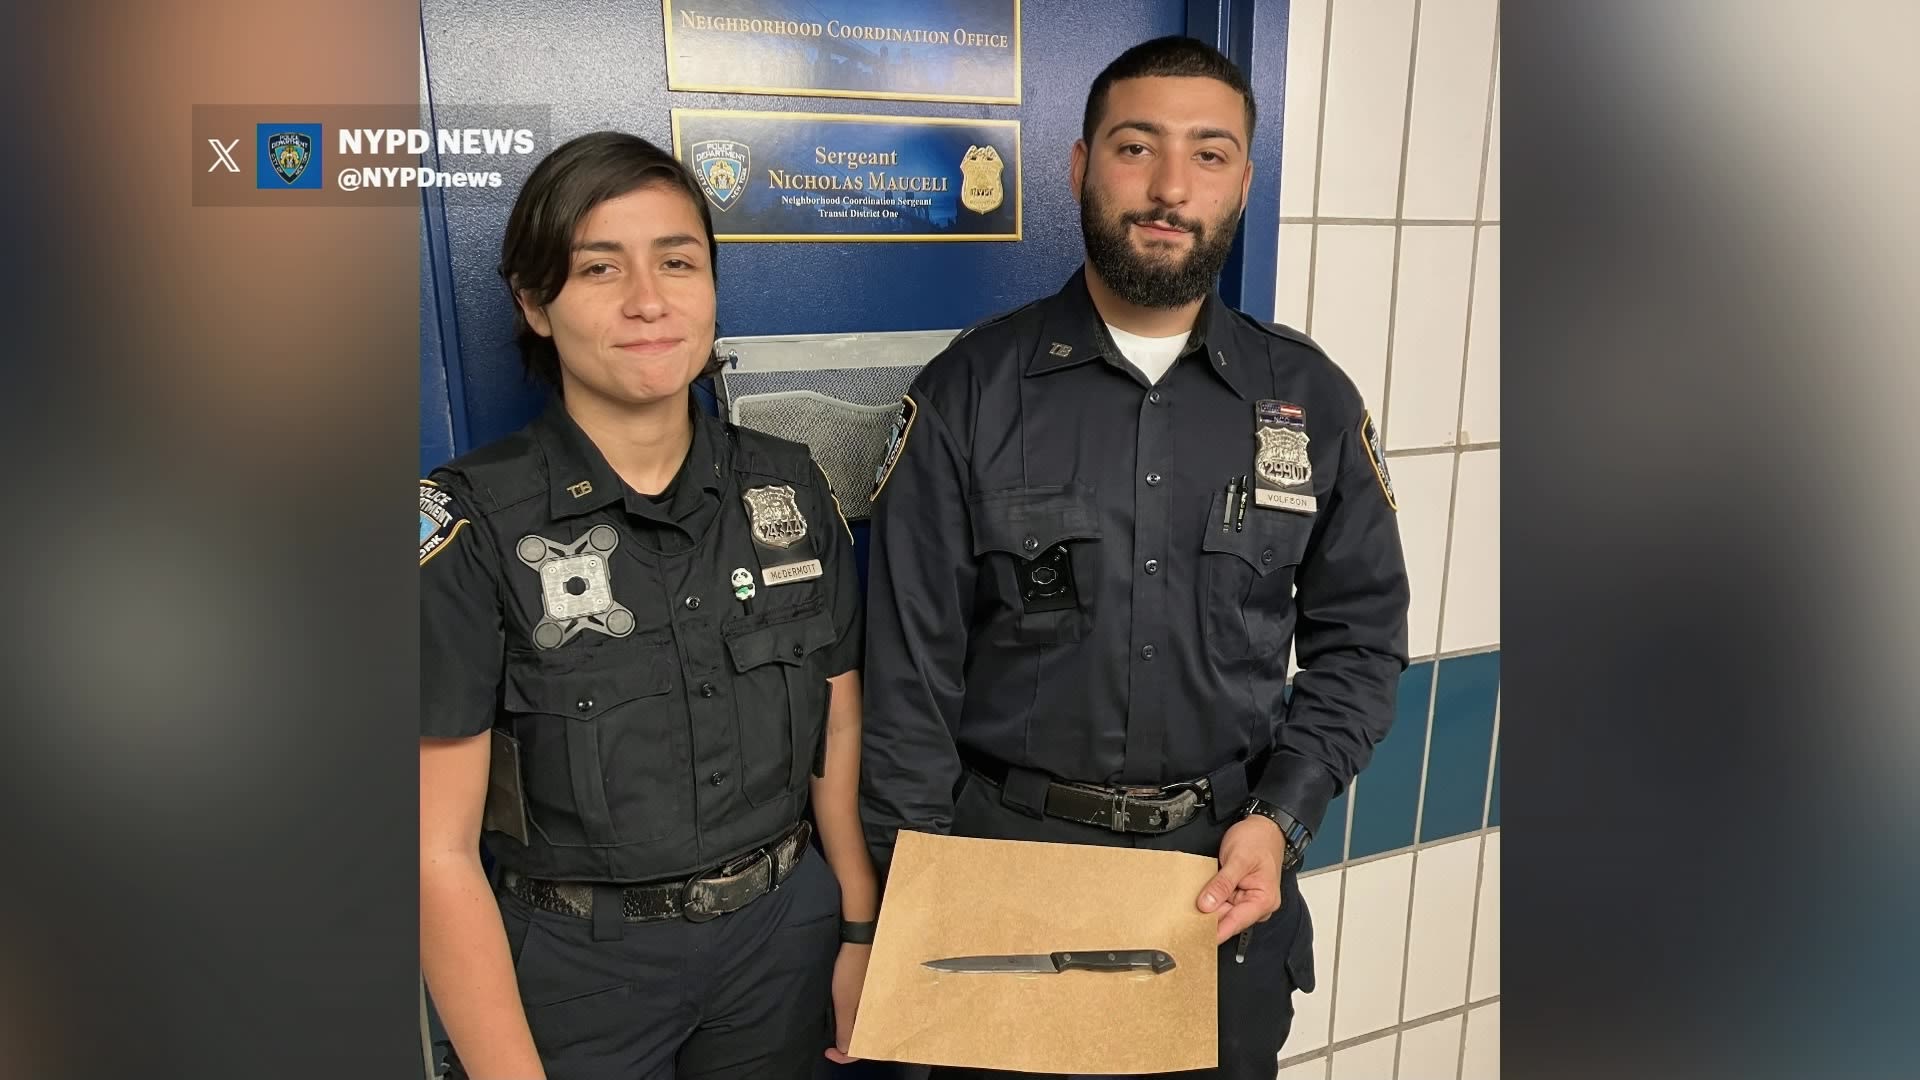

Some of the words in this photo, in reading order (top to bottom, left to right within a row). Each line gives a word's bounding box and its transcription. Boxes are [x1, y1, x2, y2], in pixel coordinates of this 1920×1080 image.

[680, 10, 823, 37] NEIGHBORHOOD
[827, 20, 950, 45] COORDINATION
[953, 28, 1009, 48] OFFICE
[815, 146, 897, 169] Sergeant
[768, 169, 863, 191] NICHOLAS
[868, 172, 948, 192] MAUCELI
[781, 195, 841, 207] Neighborhood
[842, 196, 896, 206] Coordination
[897, 198, 932, 208] Sergeant
[818, 209, 849, 218] Transit
[850, 210, 881, 218] District
[882, 210, 899, 218] One
[1263, 461, 1306, 481] 29901
